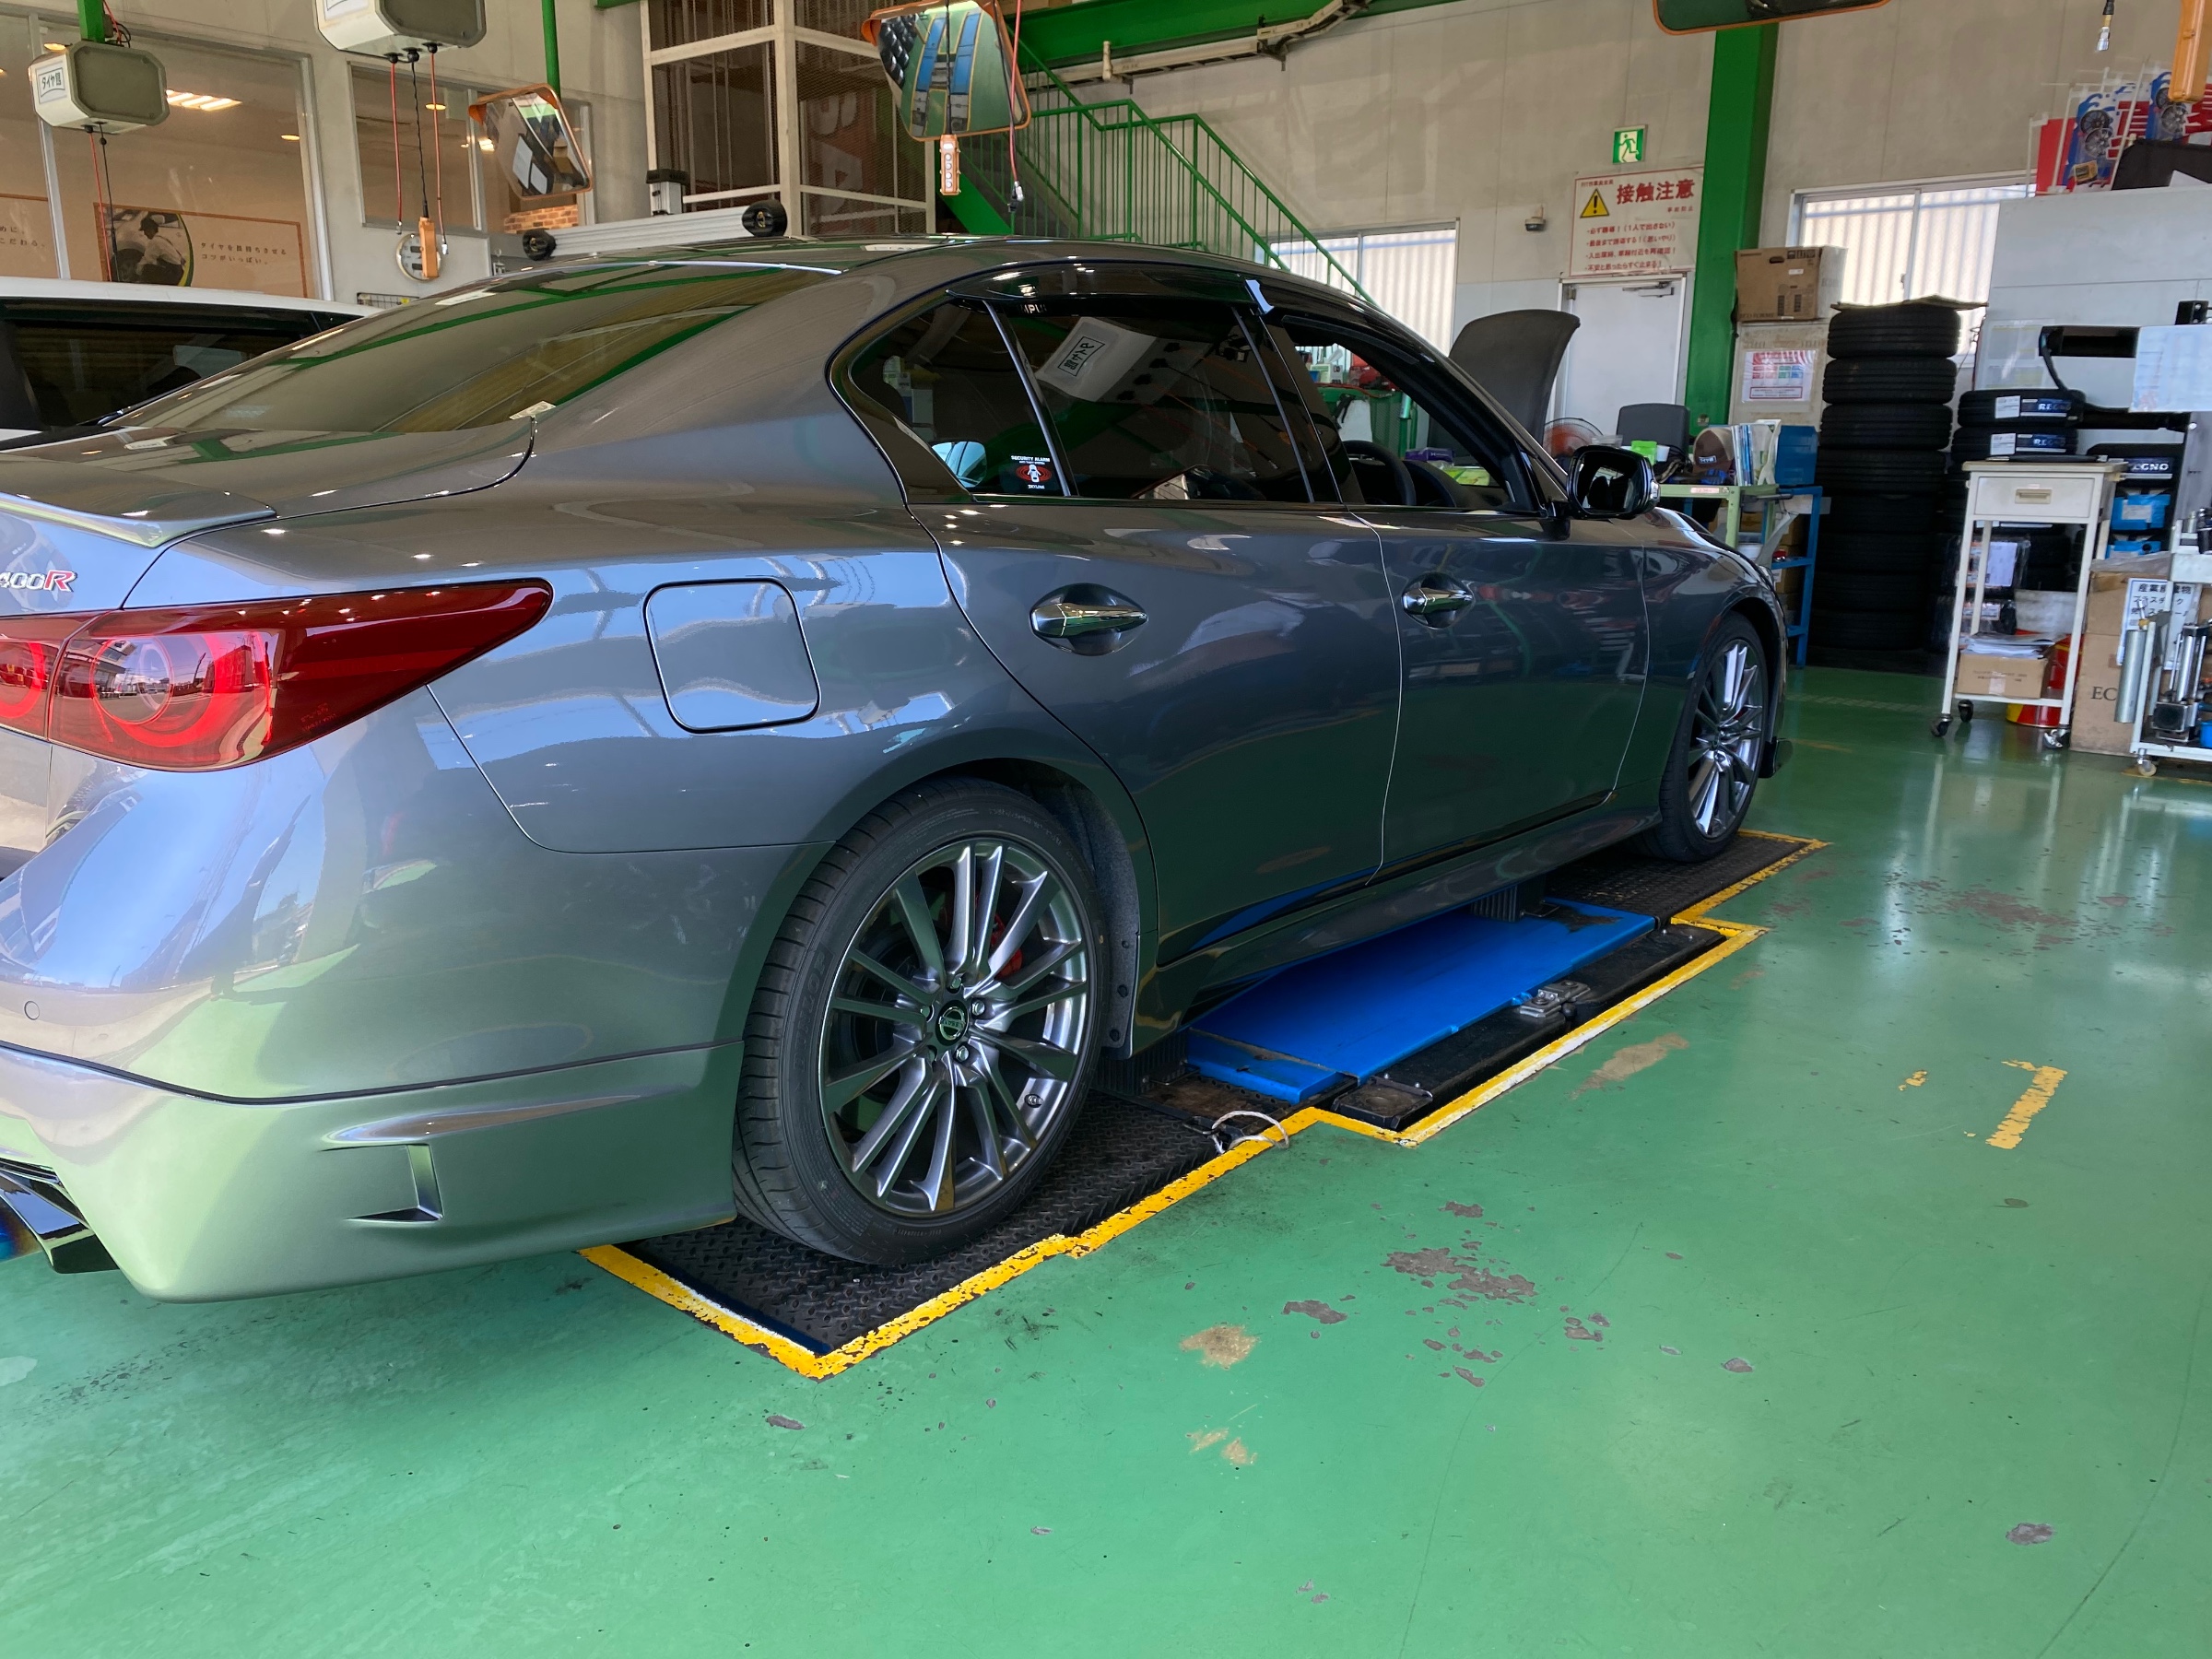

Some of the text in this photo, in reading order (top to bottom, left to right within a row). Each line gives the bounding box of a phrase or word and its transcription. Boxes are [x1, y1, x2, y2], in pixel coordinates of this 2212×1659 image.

[41, 72, 62, 90] タイヤ館
[1616, 178, 1696, 205] 接触注意
[0, 570, 77, 592] 400R
[793, 949, 827, 1072] DUNLOP
